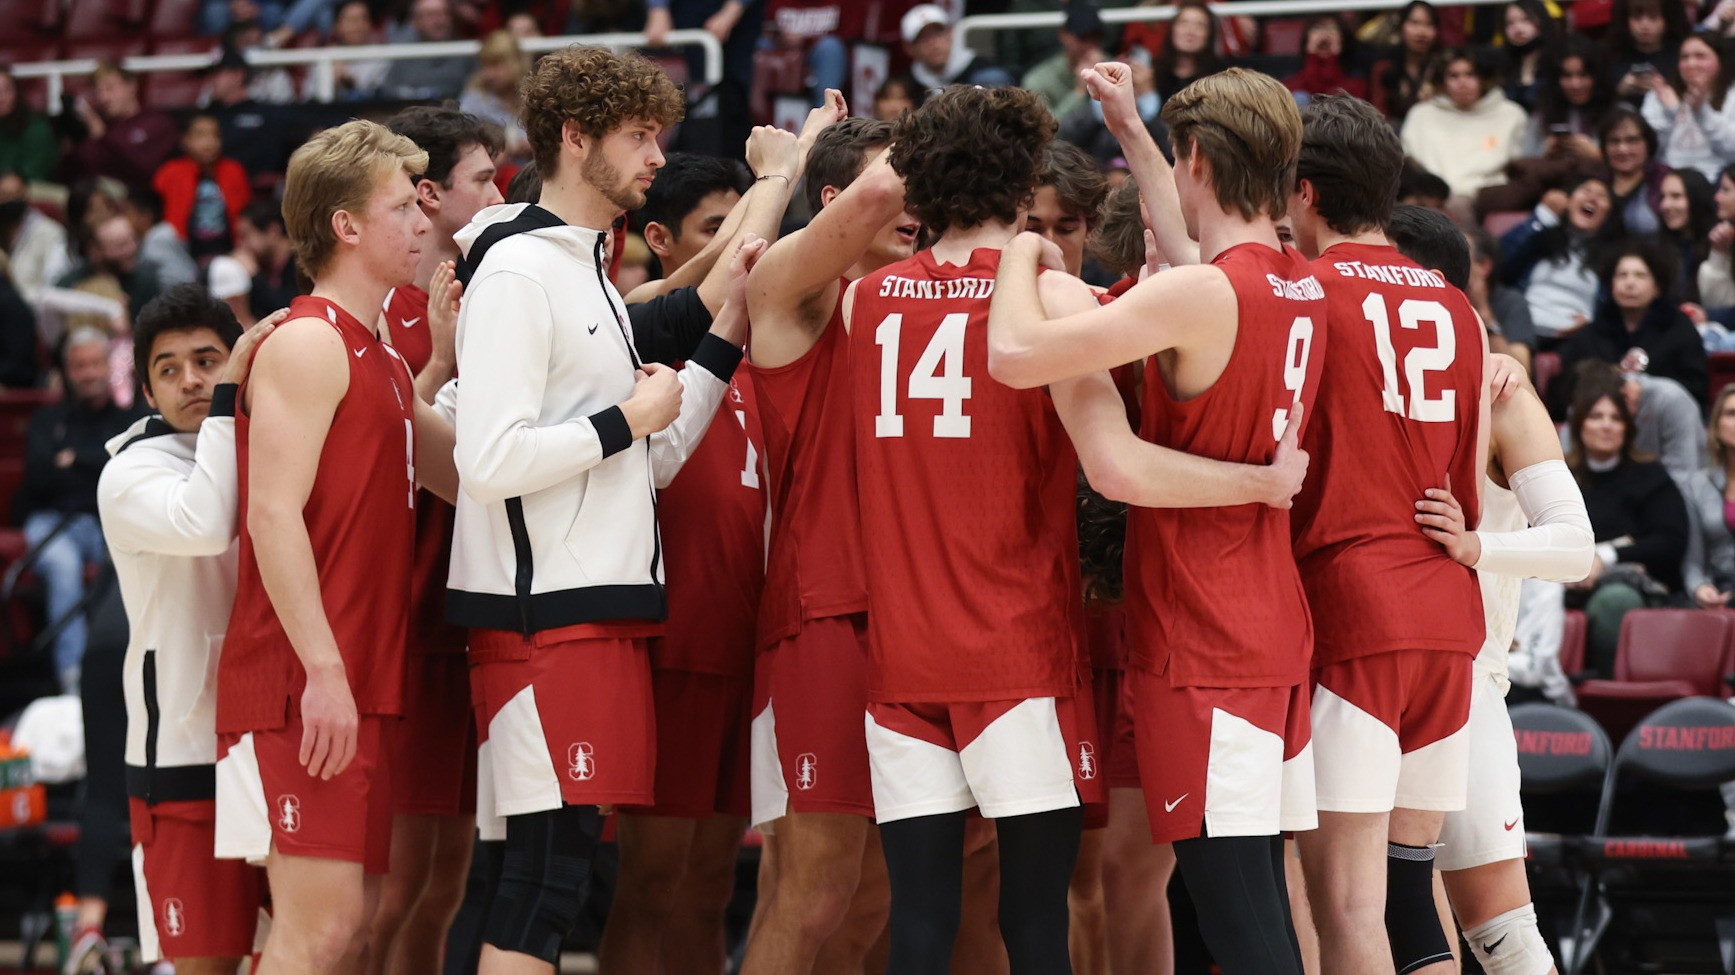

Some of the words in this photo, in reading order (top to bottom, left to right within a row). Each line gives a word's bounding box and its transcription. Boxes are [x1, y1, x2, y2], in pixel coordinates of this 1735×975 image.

[879, 275, 996, 299] STANFORD
[1333, 261, 1446, 288] STANFORD
[1362, 292, 1456, 422] 12
[875, 313, 972, 438] 14
[1272, 317, 1314, 442] 9
[1514, 728, 1592, 755] ANFORD
[1639, 725, 1735, 750] STANFOR
[1603, 840, 1689, 858] CARDINAL
